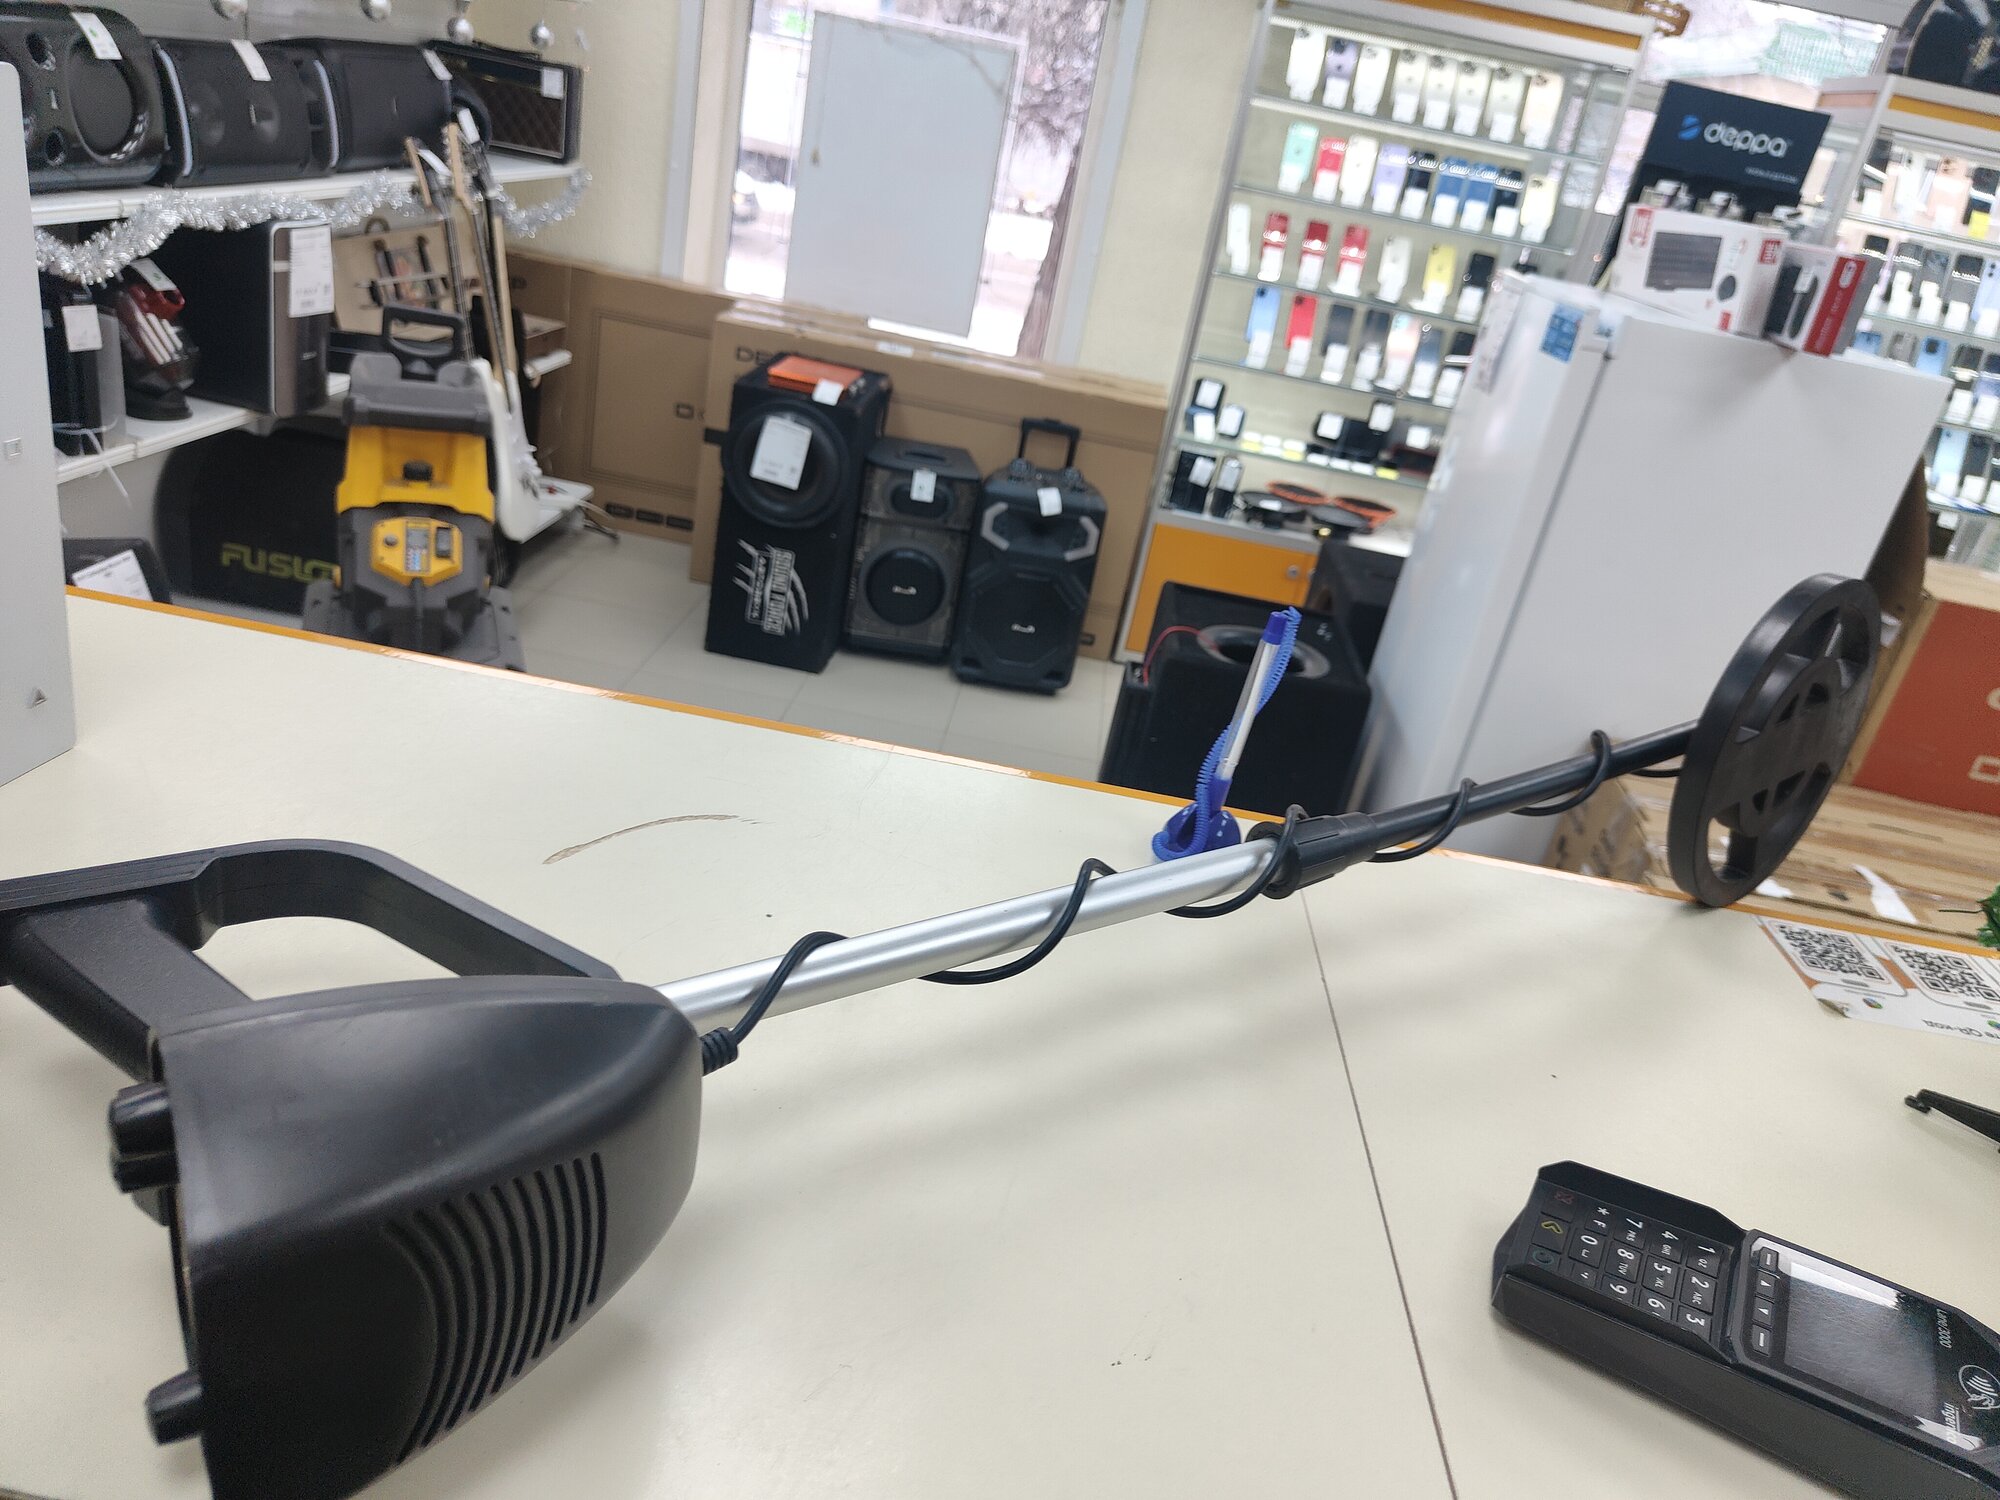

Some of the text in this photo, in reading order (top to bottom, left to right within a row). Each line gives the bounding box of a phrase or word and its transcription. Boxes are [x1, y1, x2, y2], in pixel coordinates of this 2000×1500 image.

[1703, 121, 1788, 158] deppa
[222, 542, 338, 585] FUSIO
[1626, 1217, 1643, 1230] 7
[1580, 1235, 1599, 1246] 0
[1661, 1230, 1679, 1241] 4
[1698, 1245, 1716, 1254] 1
[1617, 1248, 1635, 1276] 8 TUV
[1653, 1262, 1673, 1274] 5
[1609, 1282, 1628, 1295] 9
[1691, 1276, 1710, 1305] 2 ABC
[1647, 1298, 1666, 1311] 6
[1686, 1313, 1705, 1327] 3
